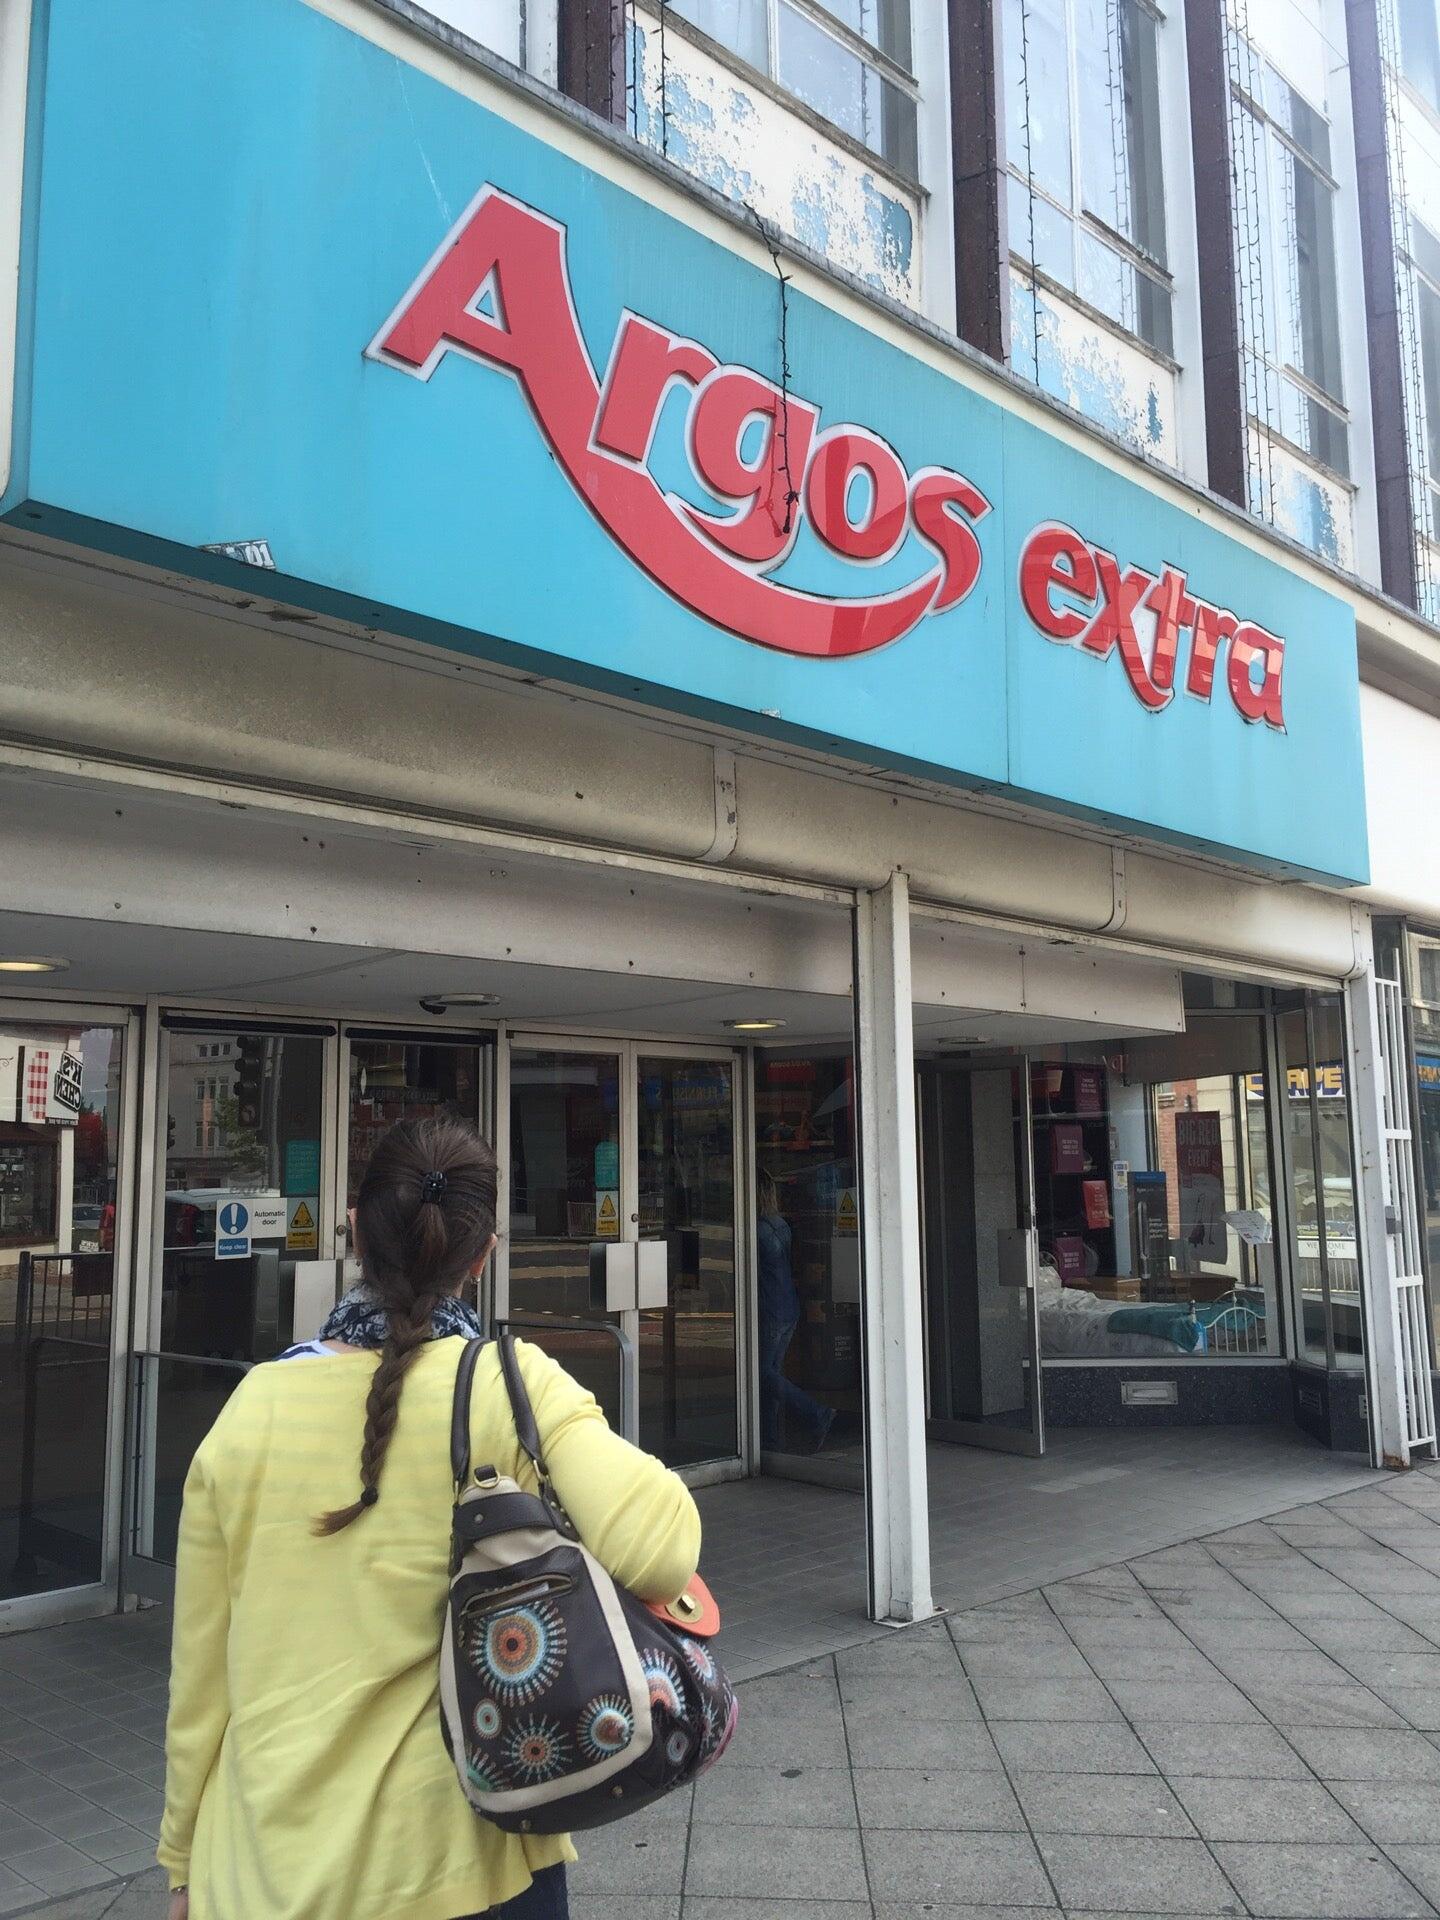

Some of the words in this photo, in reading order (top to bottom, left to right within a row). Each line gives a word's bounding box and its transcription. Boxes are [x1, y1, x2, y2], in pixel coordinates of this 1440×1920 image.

[365, 181, 992, 659] Argos
[1020, 519, 1288, 735] extra
[1179, 1119, 1196, 1145] BIG
[1199, 1118, 1218, 1145] RED
[254, 1210, 286, 1218] Automatic
[219, 1244, 232, 1252] Keep
[1306, 1241, 1345, 1250] WEOME
